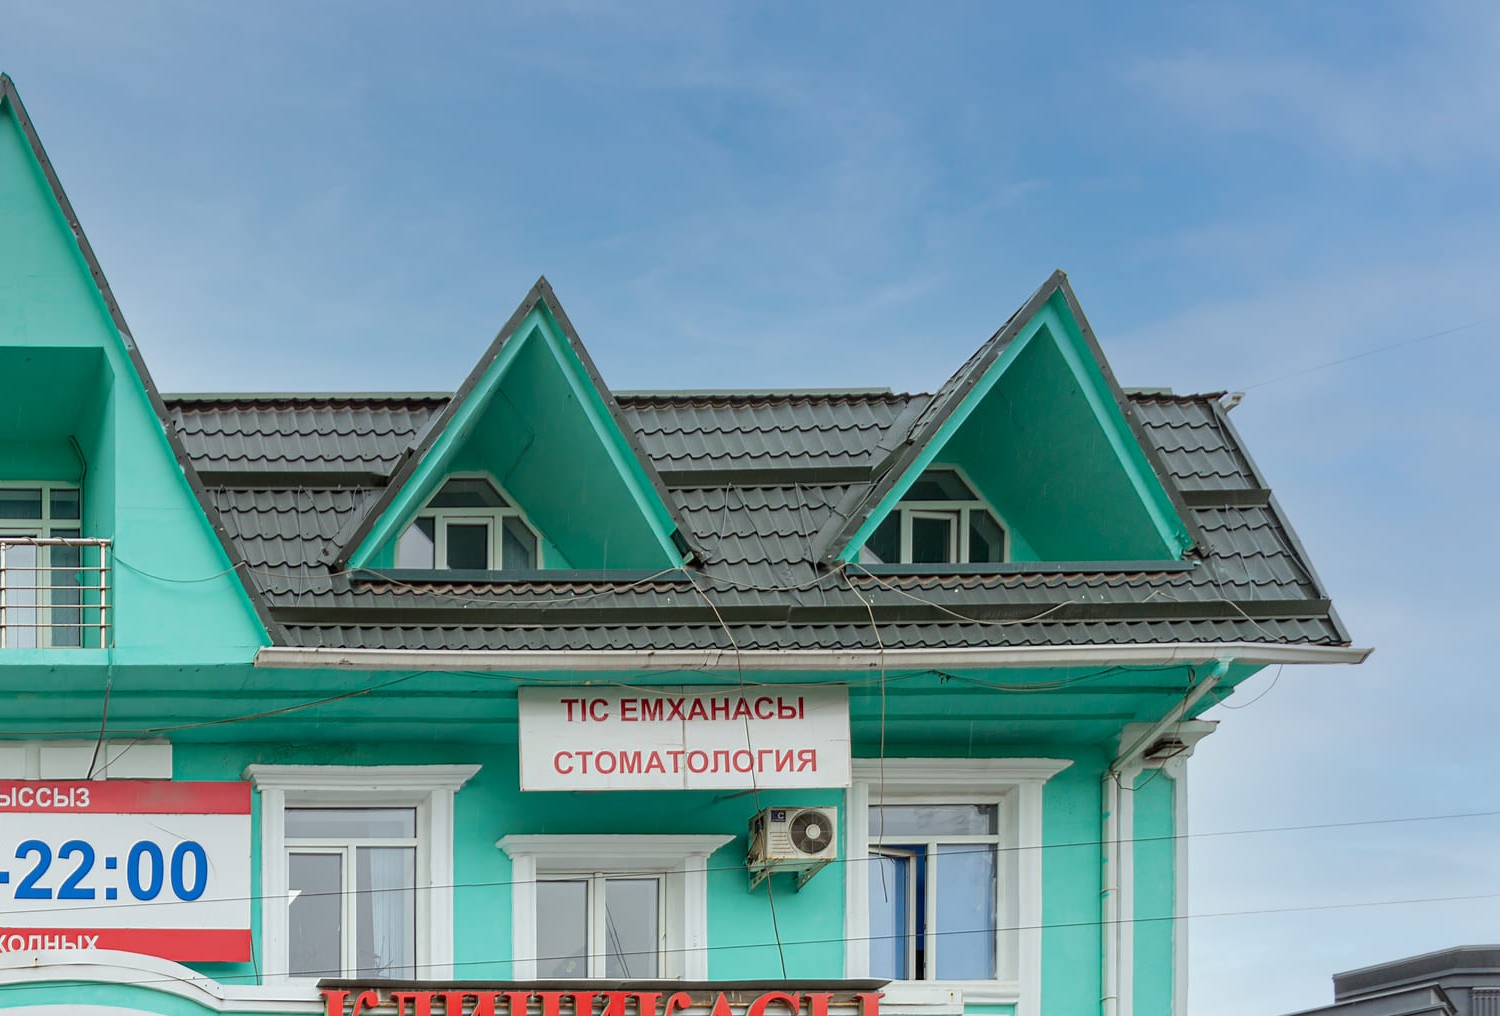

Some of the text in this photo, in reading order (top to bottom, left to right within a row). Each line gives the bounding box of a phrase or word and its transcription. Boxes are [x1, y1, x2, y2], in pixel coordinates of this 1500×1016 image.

[560, 696, 805, 722] ТІС ЕМХАНАСЫ
[553, 748, 818, 774] СТОМАТОЛОГИЯ
